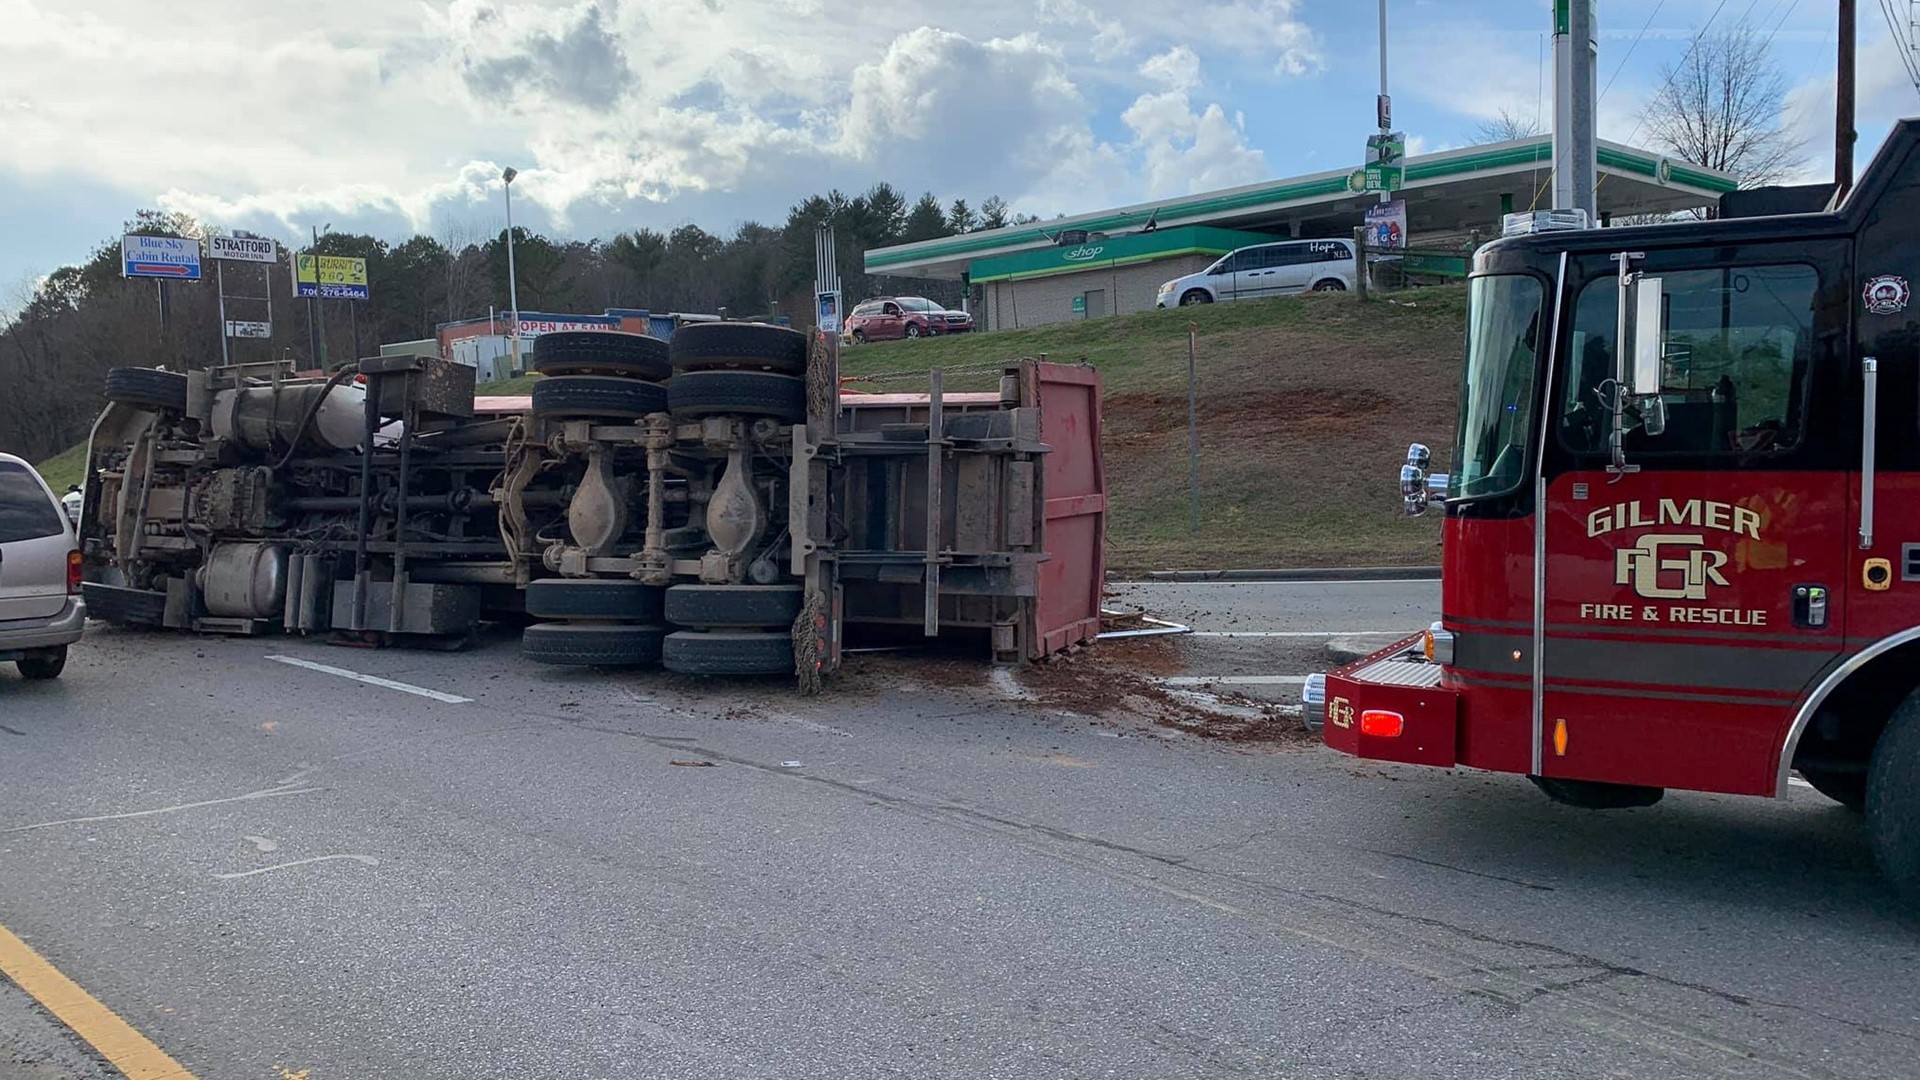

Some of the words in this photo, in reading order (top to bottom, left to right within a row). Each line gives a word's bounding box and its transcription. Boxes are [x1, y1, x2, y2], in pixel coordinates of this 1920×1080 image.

[140, 237, 162, 248] Blue
[165, 238, 184, 251] Sky
[214, 238, 271, 254] STRATFORD
[1310, 242, 1336, 253] Hope
[127, 250, 158, 261] Cabin
[161, 252, 199, 263] Rentals
[224, 250, 249, 259] MOTOR
[250, 252, 264, 260] INN
[1070, 245, 1104, 259] shop
[320, 258, 364, 273] BURRITO
[520, 321, 556, 332] OPEN
[1587, 498, 1761, 541] GILMER
[1580, 603, 1633, 620] FIRE
[1642, 606, 1660, 621] &
[1669, 606, 1767, 626] RESCUE
